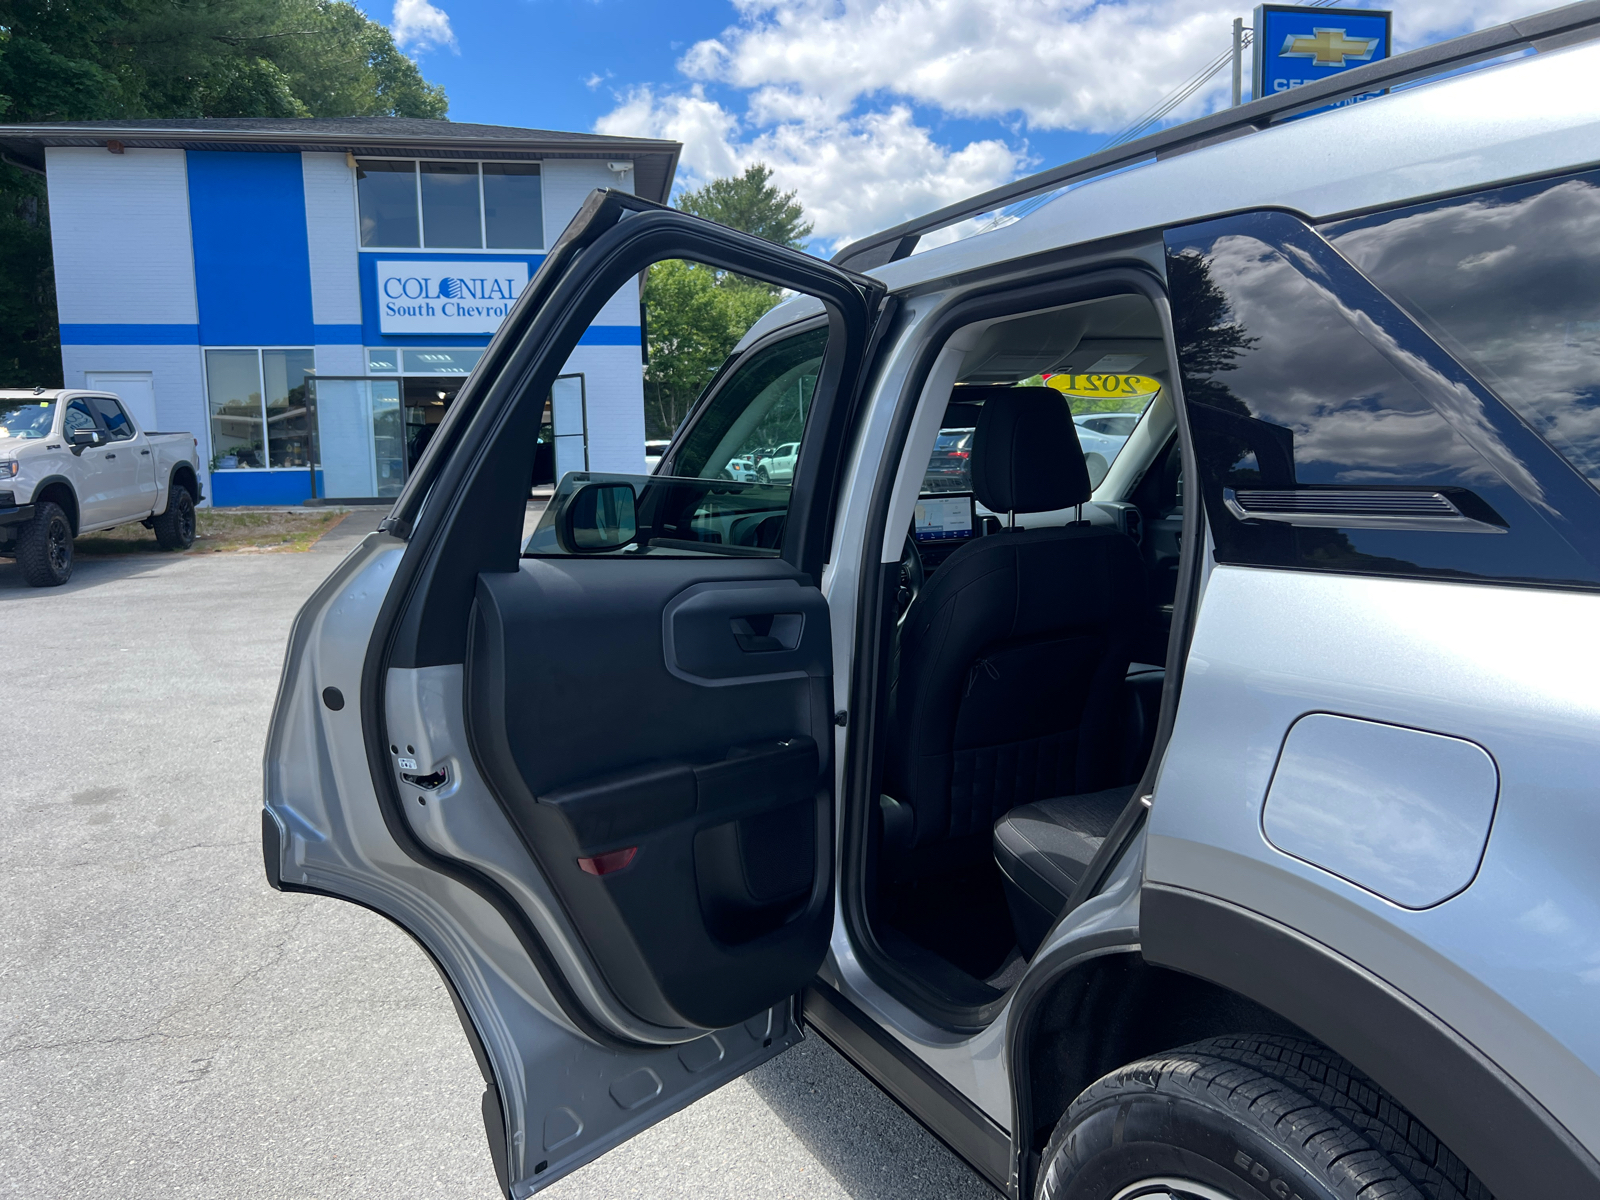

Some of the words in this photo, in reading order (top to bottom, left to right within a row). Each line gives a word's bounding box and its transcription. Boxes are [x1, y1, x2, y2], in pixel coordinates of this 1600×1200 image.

[383, 277, 519, 299] COLONIAL
[386, 302, 436, 317] South
[441, 302, 508, 317] Chevrol
[1233, 1150, 1303, 1200] EDG
